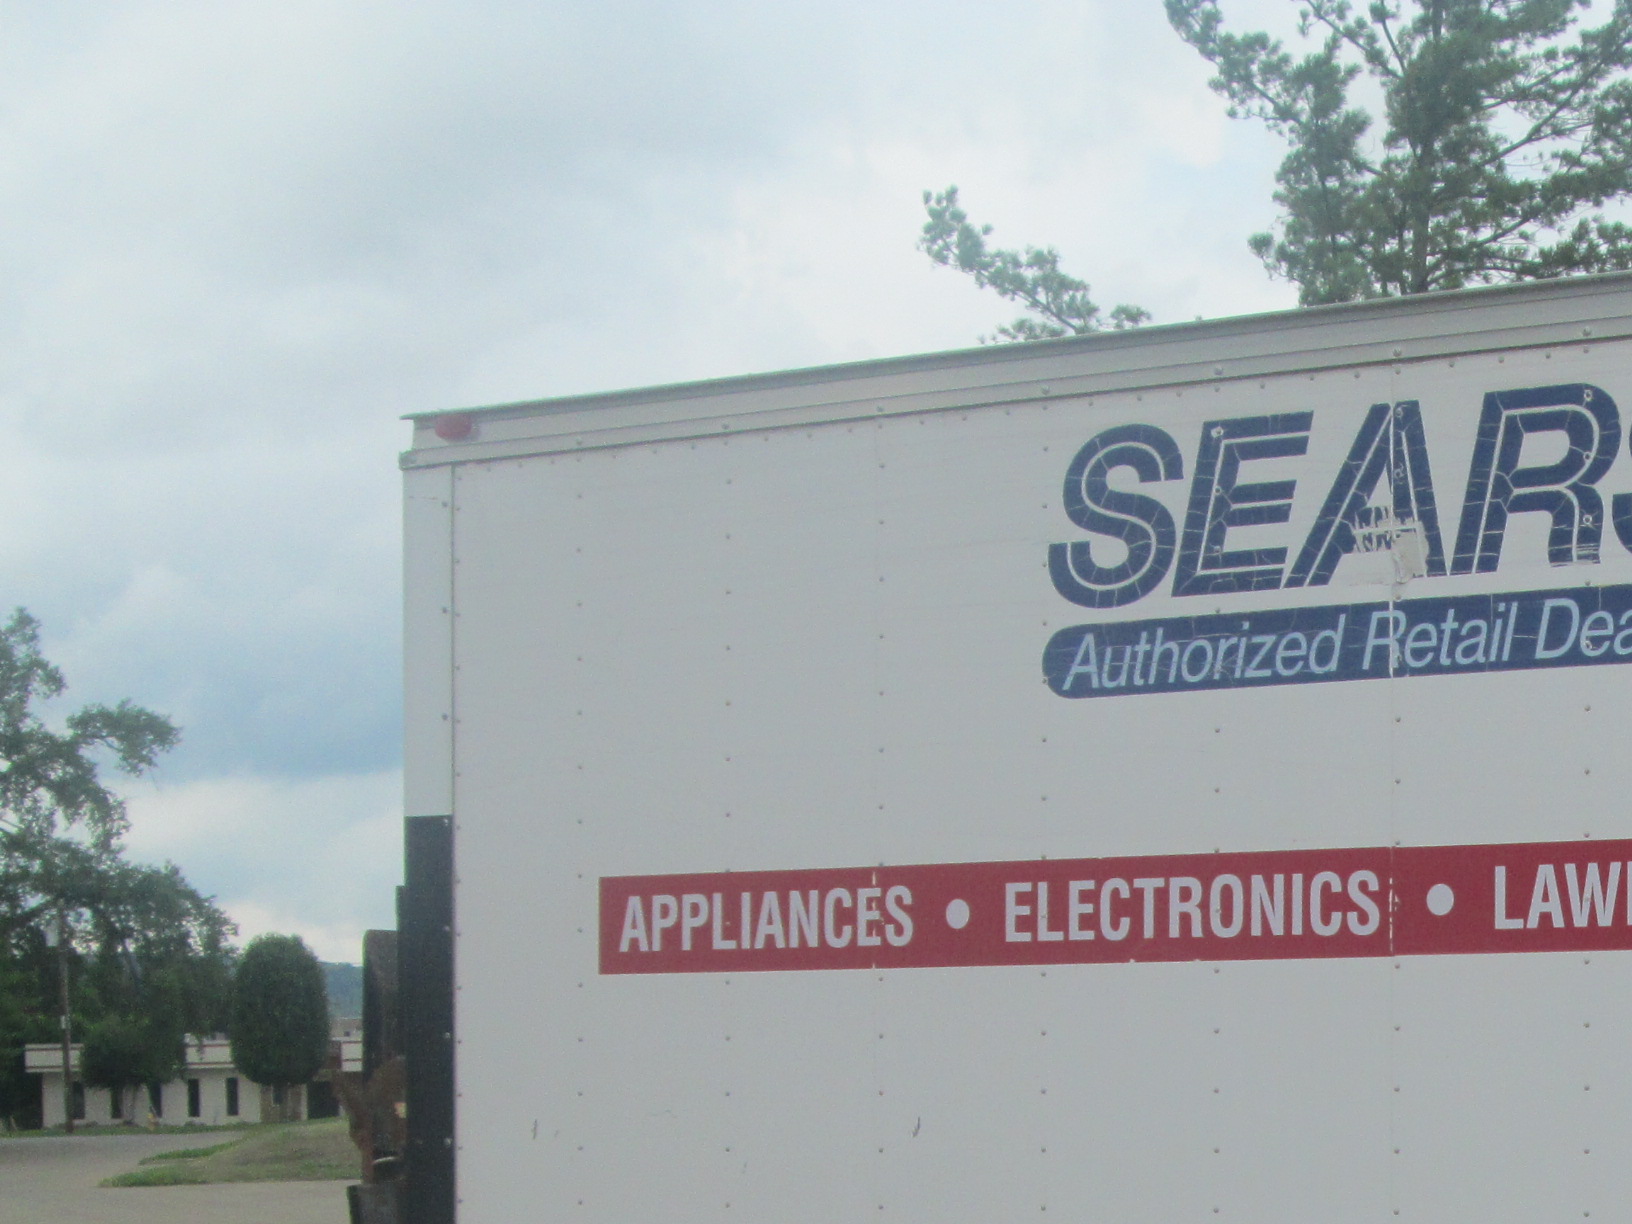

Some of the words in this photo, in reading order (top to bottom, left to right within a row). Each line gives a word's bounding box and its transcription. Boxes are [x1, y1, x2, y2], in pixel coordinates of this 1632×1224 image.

[1062, 620, 1346, 690] Authorized
[1362, 602, 1518, 671] Retail
[620, 886, 914, 952] APPLIANCES
[1005, 870, 1380, 943] ELECTRONICS
